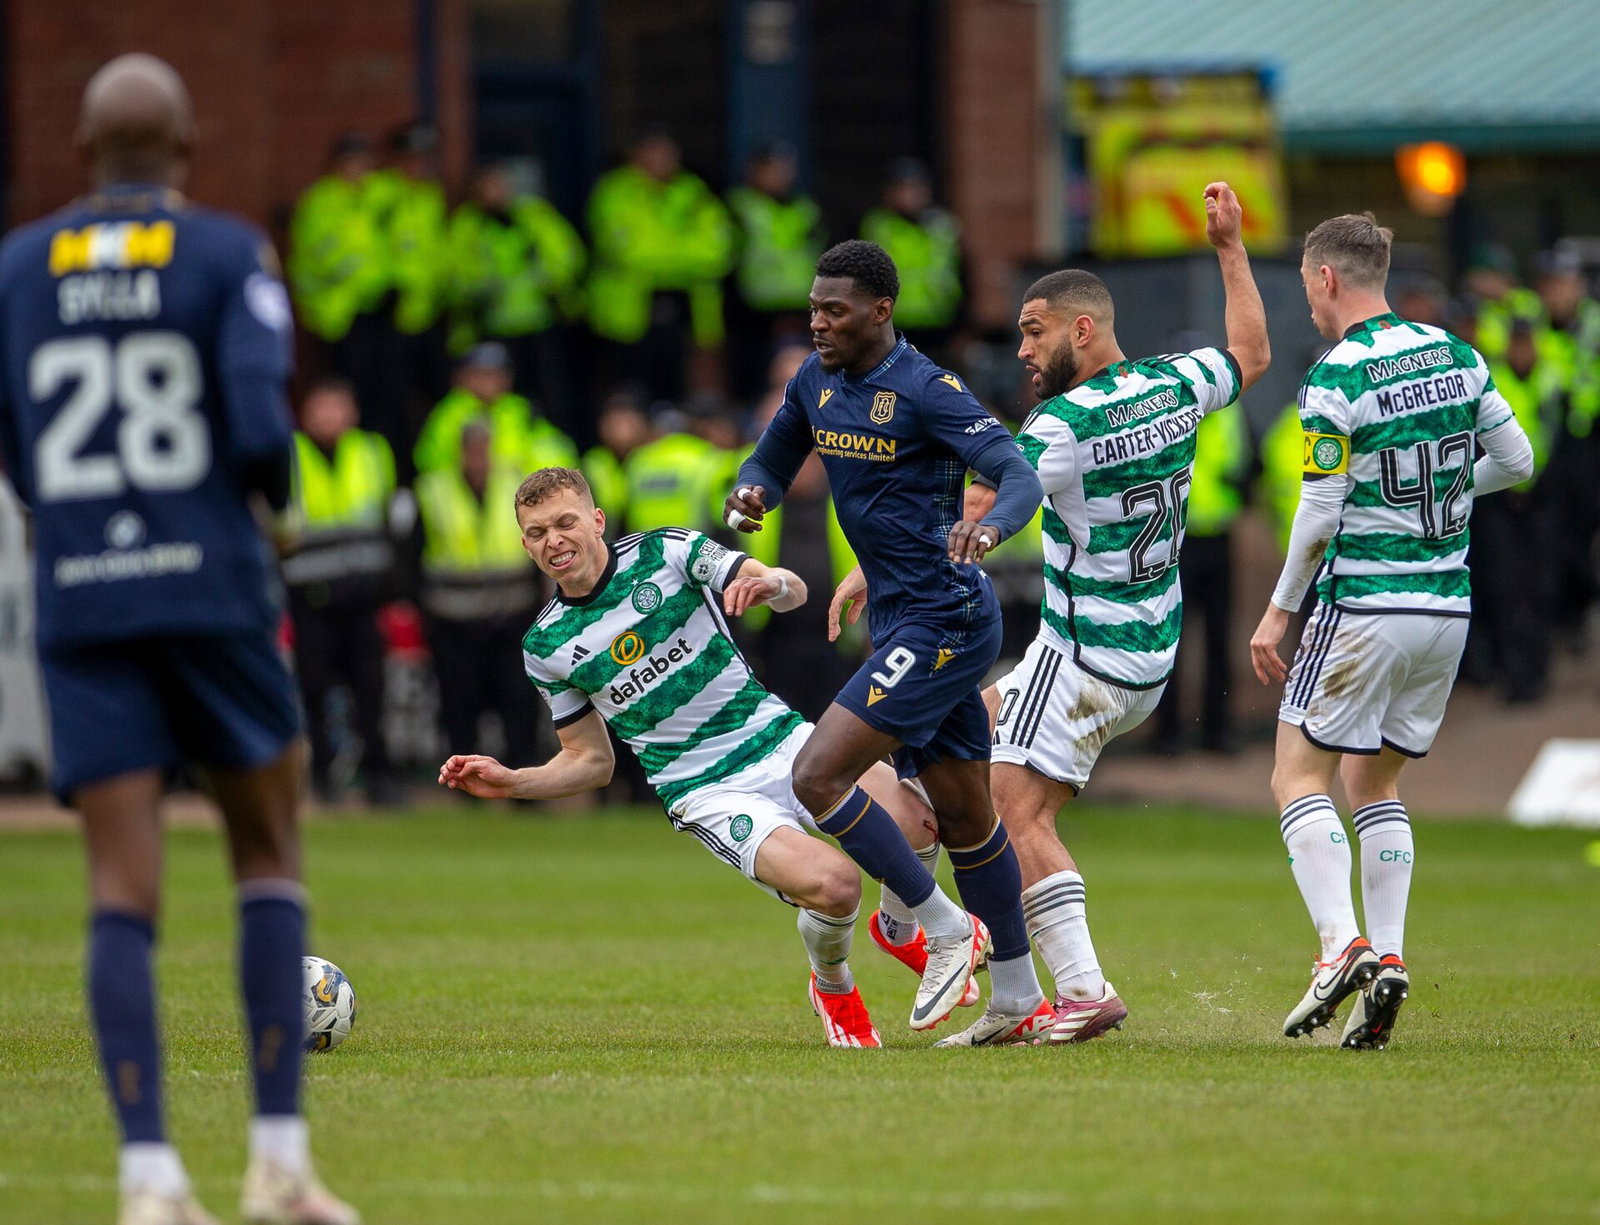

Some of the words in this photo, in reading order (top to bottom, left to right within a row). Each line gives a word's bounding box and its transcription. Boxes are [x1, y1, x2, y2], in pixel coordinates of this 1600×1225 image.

[1367, 347, 1453, 383] MAGNERS
[1106, 389, 1178, 427] MAGNERS
[1376, 374, 1467, 417] McGREGOR
[29, 331, 211, 503] 28
[816, 429, 896, 454] CROWN
[845, 449, 867, 460] services
[867, 452, 896, 462] limited
[1378, 430, 1473, 540] 42
[610, 637, 693, 706] dafabet
[871, 646, 916, 688] 9
[1330, 831, 1346, 844] CF
[1380, 849, 1411, 864] CFC
